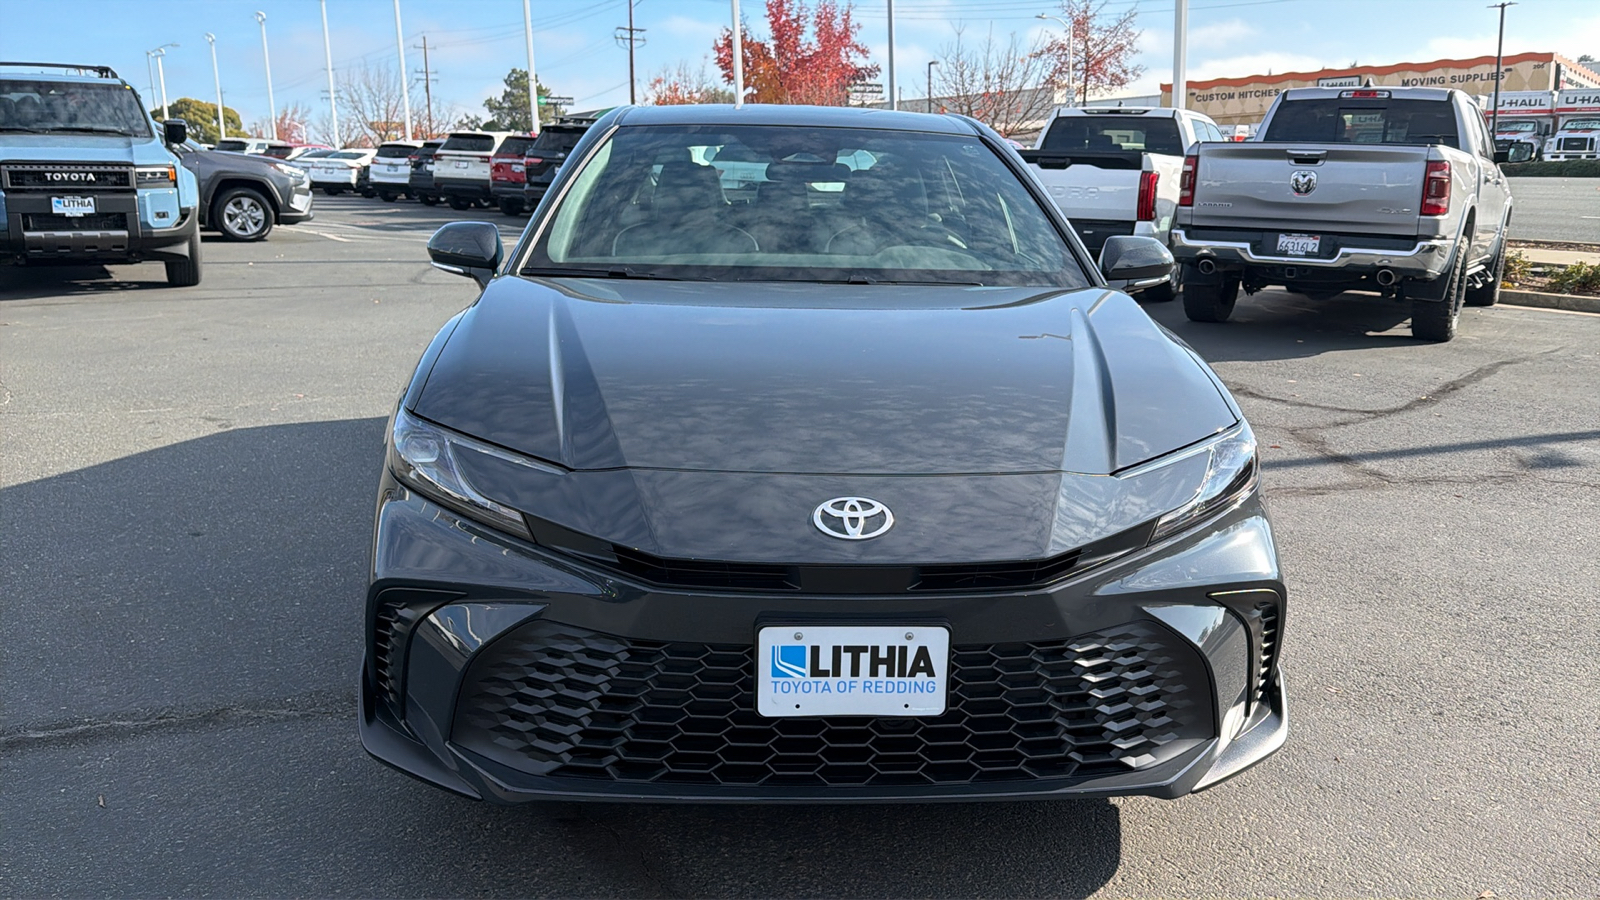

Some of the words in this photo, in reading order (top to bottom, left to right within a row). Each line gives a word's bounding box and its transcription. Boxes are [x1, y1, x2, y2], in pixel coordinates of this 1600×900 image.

[1401, 75, 1446, 87] MOVING
[1449, 71, 1506, 83] SUPPLIES
[1195, 91, 1236, 103] CUSTOM
[1238, 88, 1281, 100] HITCHES
[44, 172, 96, 181] TOYOTA
[63, 199, 93, 208] LITHIA
[809, 645, 936, 678] LITHIA
[771, 680, 832, 694] TOYOTA
[836, 680, 858, 694] OF
[862, 680, 937, 694] REDDING
